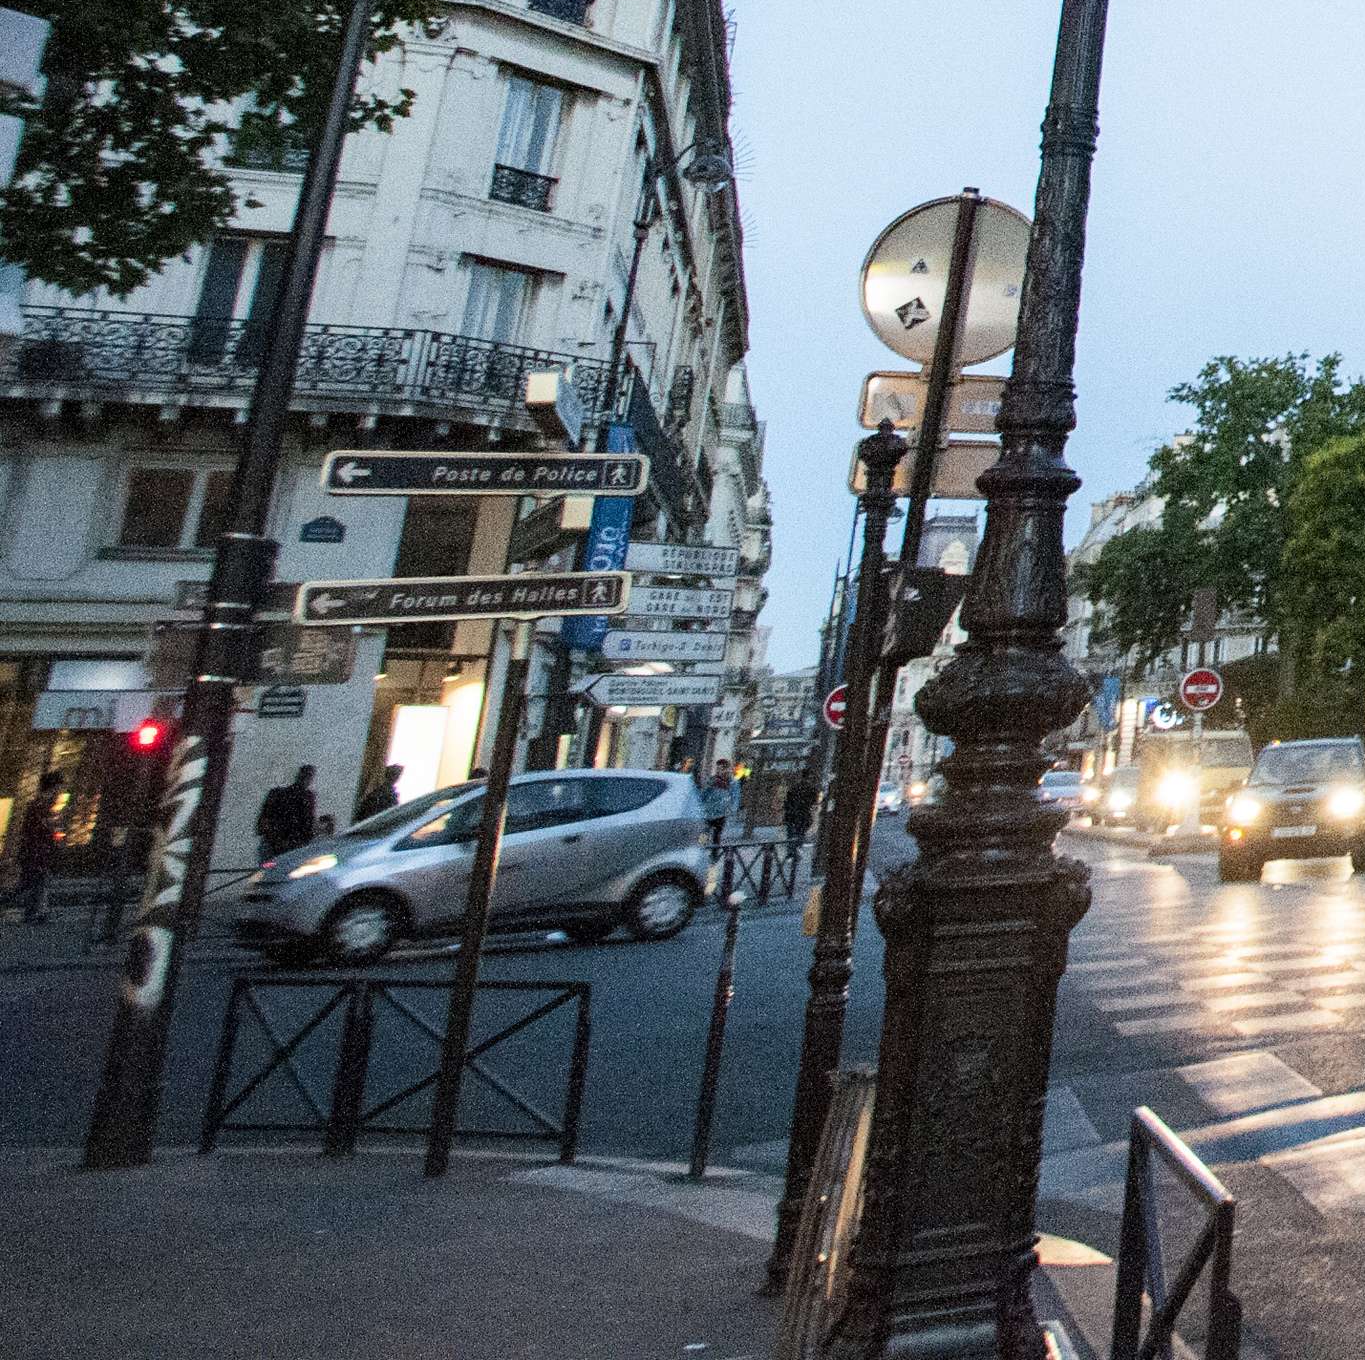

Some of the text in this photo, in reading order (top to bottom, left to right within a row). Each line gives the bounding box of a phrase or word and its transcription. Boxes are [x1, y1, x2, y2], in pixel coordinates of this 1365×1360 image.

[432, 465, 598, 482] Poste de Police
[389, 586, 579, 610] Forum des Halles
